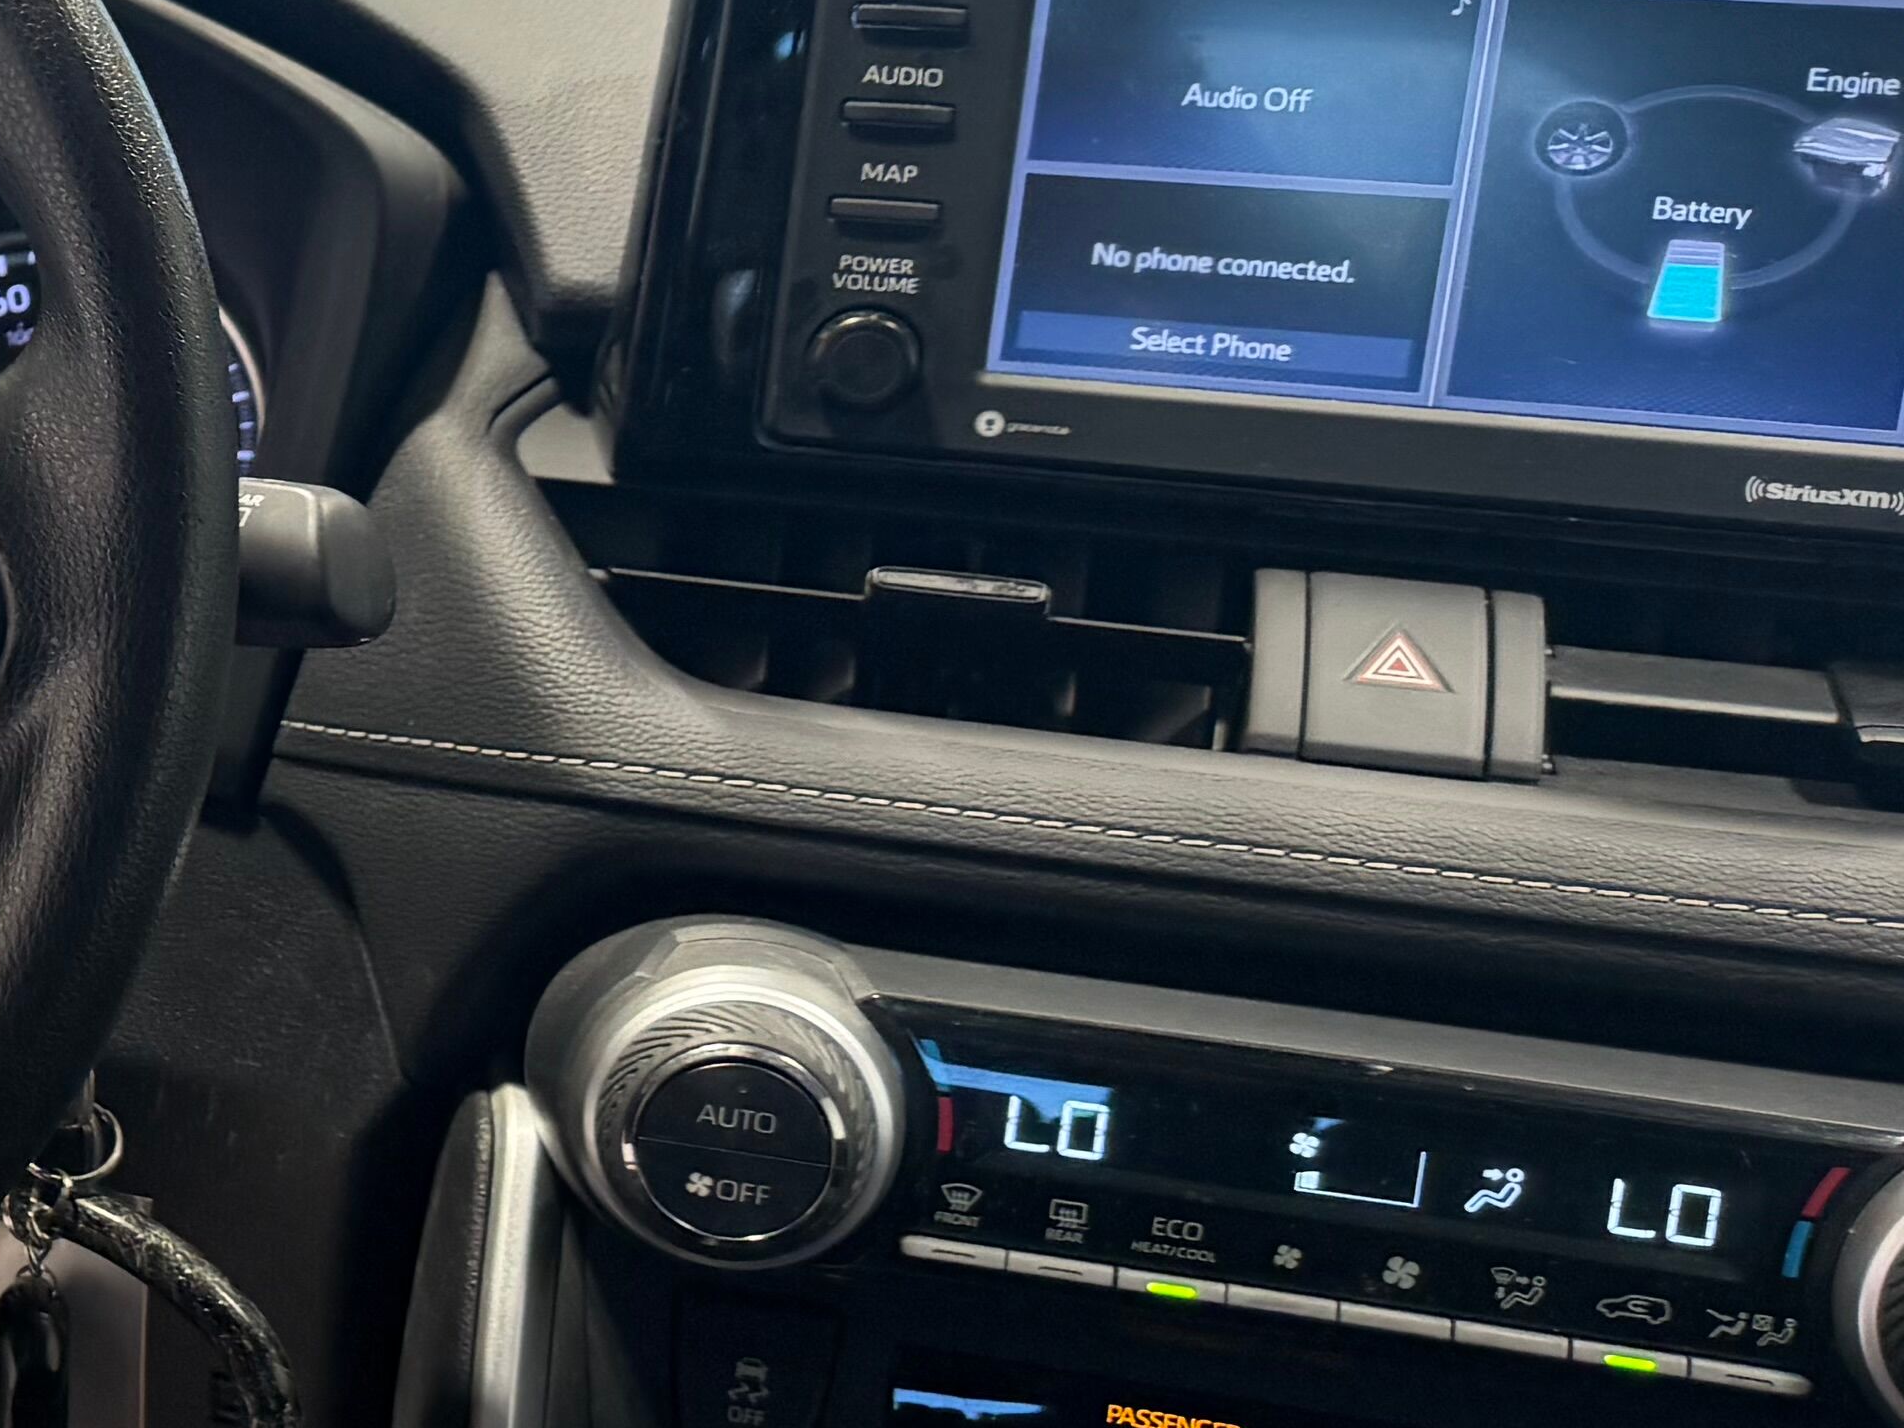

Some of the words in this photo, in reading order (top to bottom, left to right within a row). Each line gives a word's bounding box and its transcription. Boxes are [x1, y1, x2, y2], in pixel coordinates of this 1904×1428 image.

[860, 64, 944, 89] AUDIO
[1805, 66, 1902, 100] Engine
[1180, 82, 1258, 110] Audio
[1263, 87, 1314, 113] Off
[860, 162, 919, 184] MAP
[1651, 194, 1753, 231] Battery
[838, 254, 914, 276] POWER
[1090, 241, 1132, 267] No
[1133, 245, 1215, 275] phone
[1216, 259, 1356, 285] connected.
[831, 273, 920, 295] VOLUME
[1128, 326, 1208, 356] Select
[1209, 332, 1293, 362] Phone
[695, 1103, 778, 1136] AUTO
[715, 1178, 772, 1207] OFF
[933, 1210, 983, 1228] FRONT
[1150, 1216, 1206, 1243] ECO
[1044, 1227, 1085, 1245] REAR
[1130, 1239, 1217, 1264] HEAT/COOL
[726, 1404, 766, 1427] OFF
